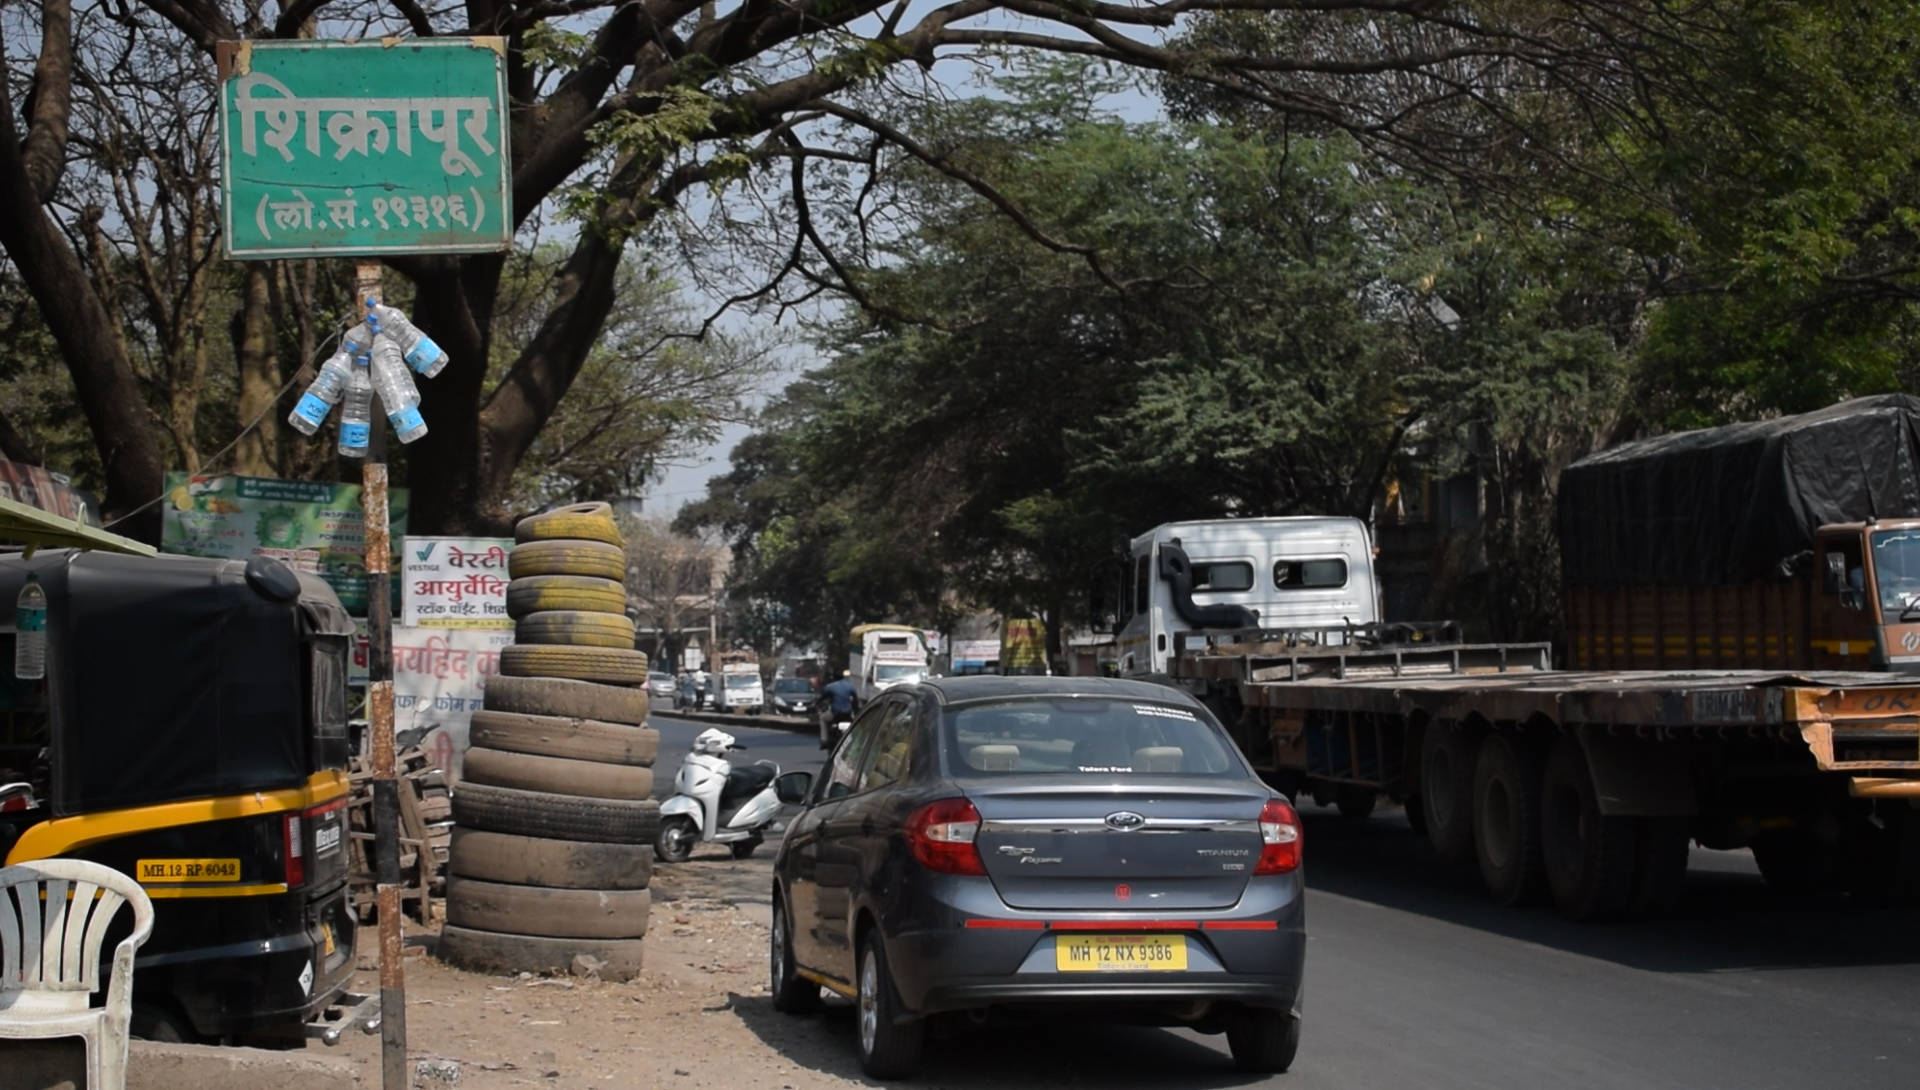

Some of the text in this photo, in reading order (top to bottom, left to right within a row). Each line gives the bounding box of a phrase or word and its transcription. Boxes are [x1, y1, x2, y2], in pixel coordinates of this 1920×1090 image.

[234, 71, 496, 178] शिक्रापूर
[321, 511, 363, 520] INSPIRED
[319, 533, 363, 542] POWERED
[448, 546, 508, 569] वेस्टी
[407, 564, 440, 572] VESTIGE
[414, 574, 510, 602] आयुर्वेदि
[417, 602, 446, 615] स्टॉक
[1196, 849, 1249, 857] TITANIUM
[1070, 944, 1172, 961] MH 12 NX 9386
